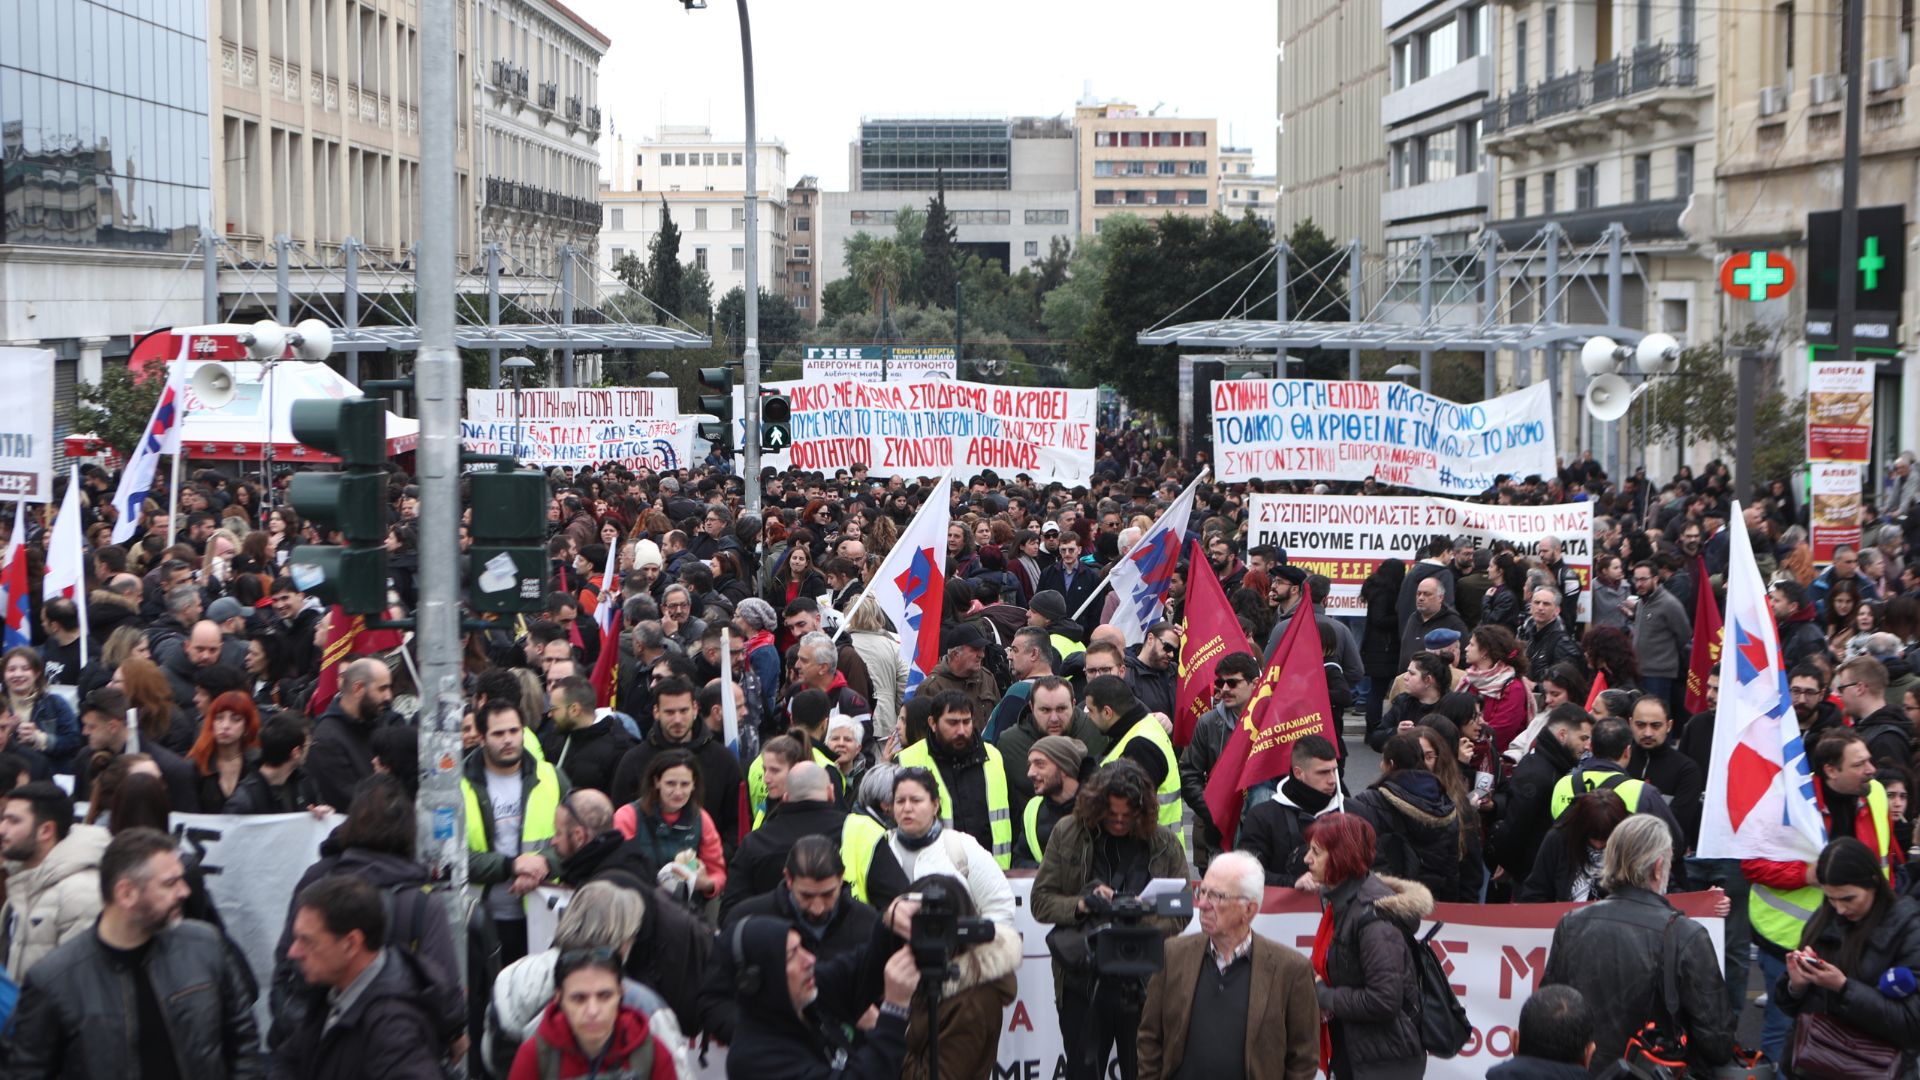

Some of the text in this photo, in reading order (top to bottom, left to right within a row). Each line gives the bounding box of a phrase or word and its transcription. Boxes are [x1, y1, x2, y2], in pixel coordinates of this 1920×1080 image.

[807, 348, 862, 359] ΓΣΕΕ
[807, 361, 862, 369] ΑΠΕΡΓΟΥΜΕ
[865, 361, 879, 369] ΓΙΑ
[897, 361, 955, 369] ΑΥΤΟΝΟΗΤΟ
[496, 393, 505, 418] Η
[562, 401, 577, 418] ΠΟΥ
[577, 390, 612, 417] ΓΕΝΝΑ
[616, 390, 654, 417] ΤΕΜΠΗ
[790, 384, 829, 412] ΔΙΚΙΟ
[834, 381, 853, 407] ΜΕ
[908, 383, 935, 410] ΣΤΟ
[938, 384, 987, 413] ΔΡΟΜΟ
[993, 389, 1012, 416] ΘΑ
[1015, 391, 1068, 420] ΚΡΙΘΕΙ
[1272, 382, 1327, 408] ΟΡΓΗ
[550, 426, 591, 444] ΠΑΙΔΙ
[854, 408, 871, 436] ΤΟ
[1062, 424, 1090, 450] ΜΑΣ
[1216, 416, 1243, 445] ΤΟ
[1291, 413, 1313, 440] ΘΑ
[1319, 413, 1380, 441] ΚΡΙΘΕΙ
[599, 441, 650, 460] ΚΡΑΤΟΣ
[884, 437, 954, 467] ΣΥΛΛΟΓΟΙ
[966, 437, 1040, 471] ΑΘΗΝΑΣ
[1260, 502, 1589, 533] ΣΥΣΠΕΙΡΩΝΟΜΑΣΤΕ ΣΤΟ ΣΩΜΑΤΕΙΟ ΜΑΣ
[1259, 531, 1354, 549] ΠΑΛΕΥΟΥΜΕ
[1360, 533, 1384, 550] ΓΙΑ
